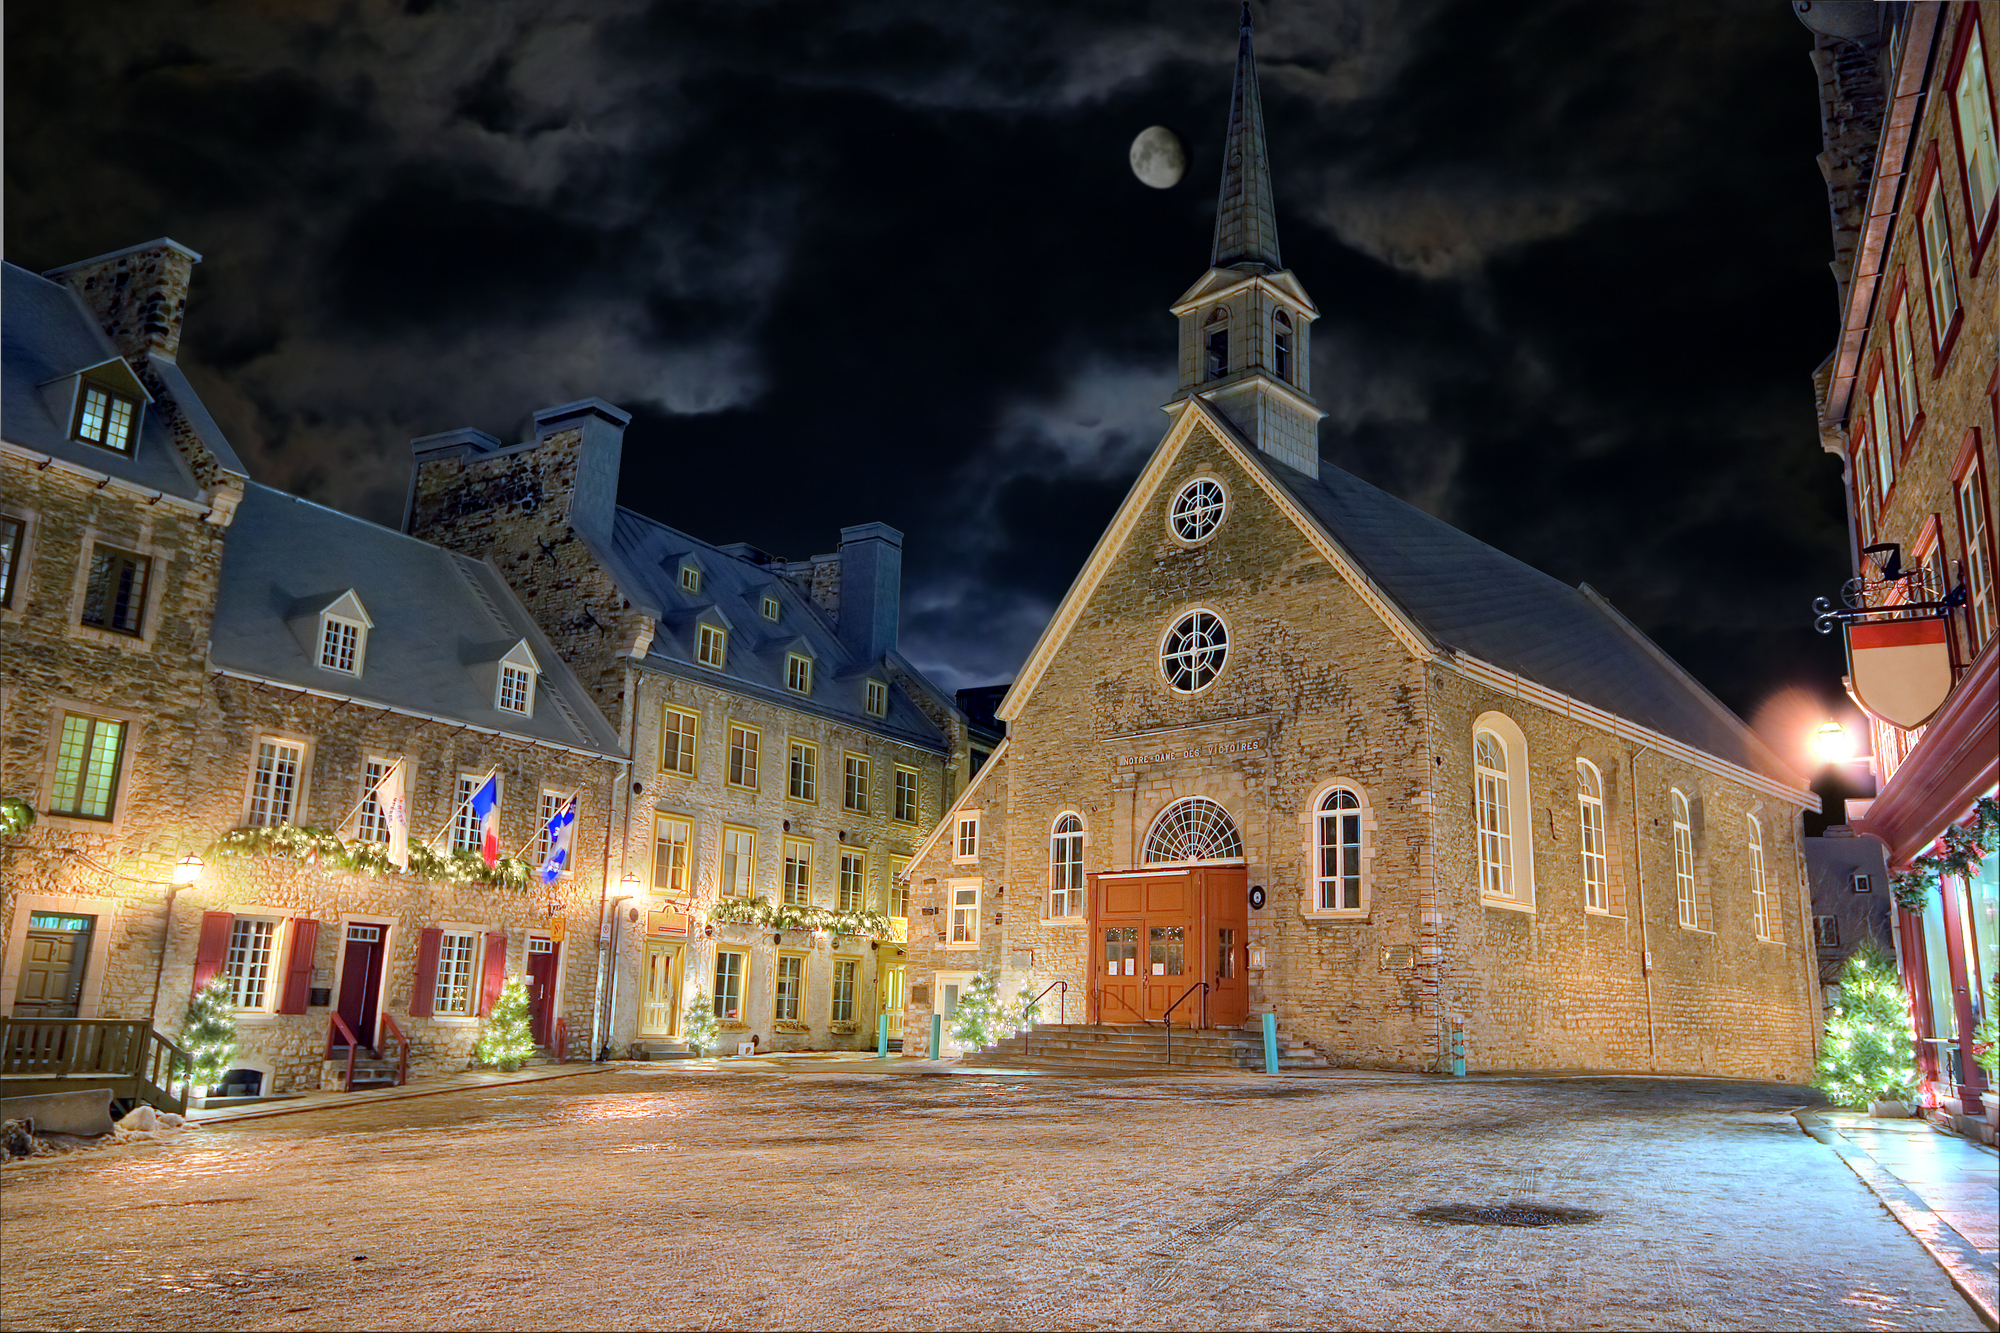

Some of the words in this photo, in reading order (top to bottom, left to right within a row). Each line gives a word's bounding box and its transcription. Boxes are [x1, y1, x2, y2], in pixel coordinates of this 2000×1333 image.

[1123, 752, 1176, 766] NOTRE-DAME
[1183, 748, 1200, 758] DES
[1208, 741, 1259, 755] VICTOIRES
